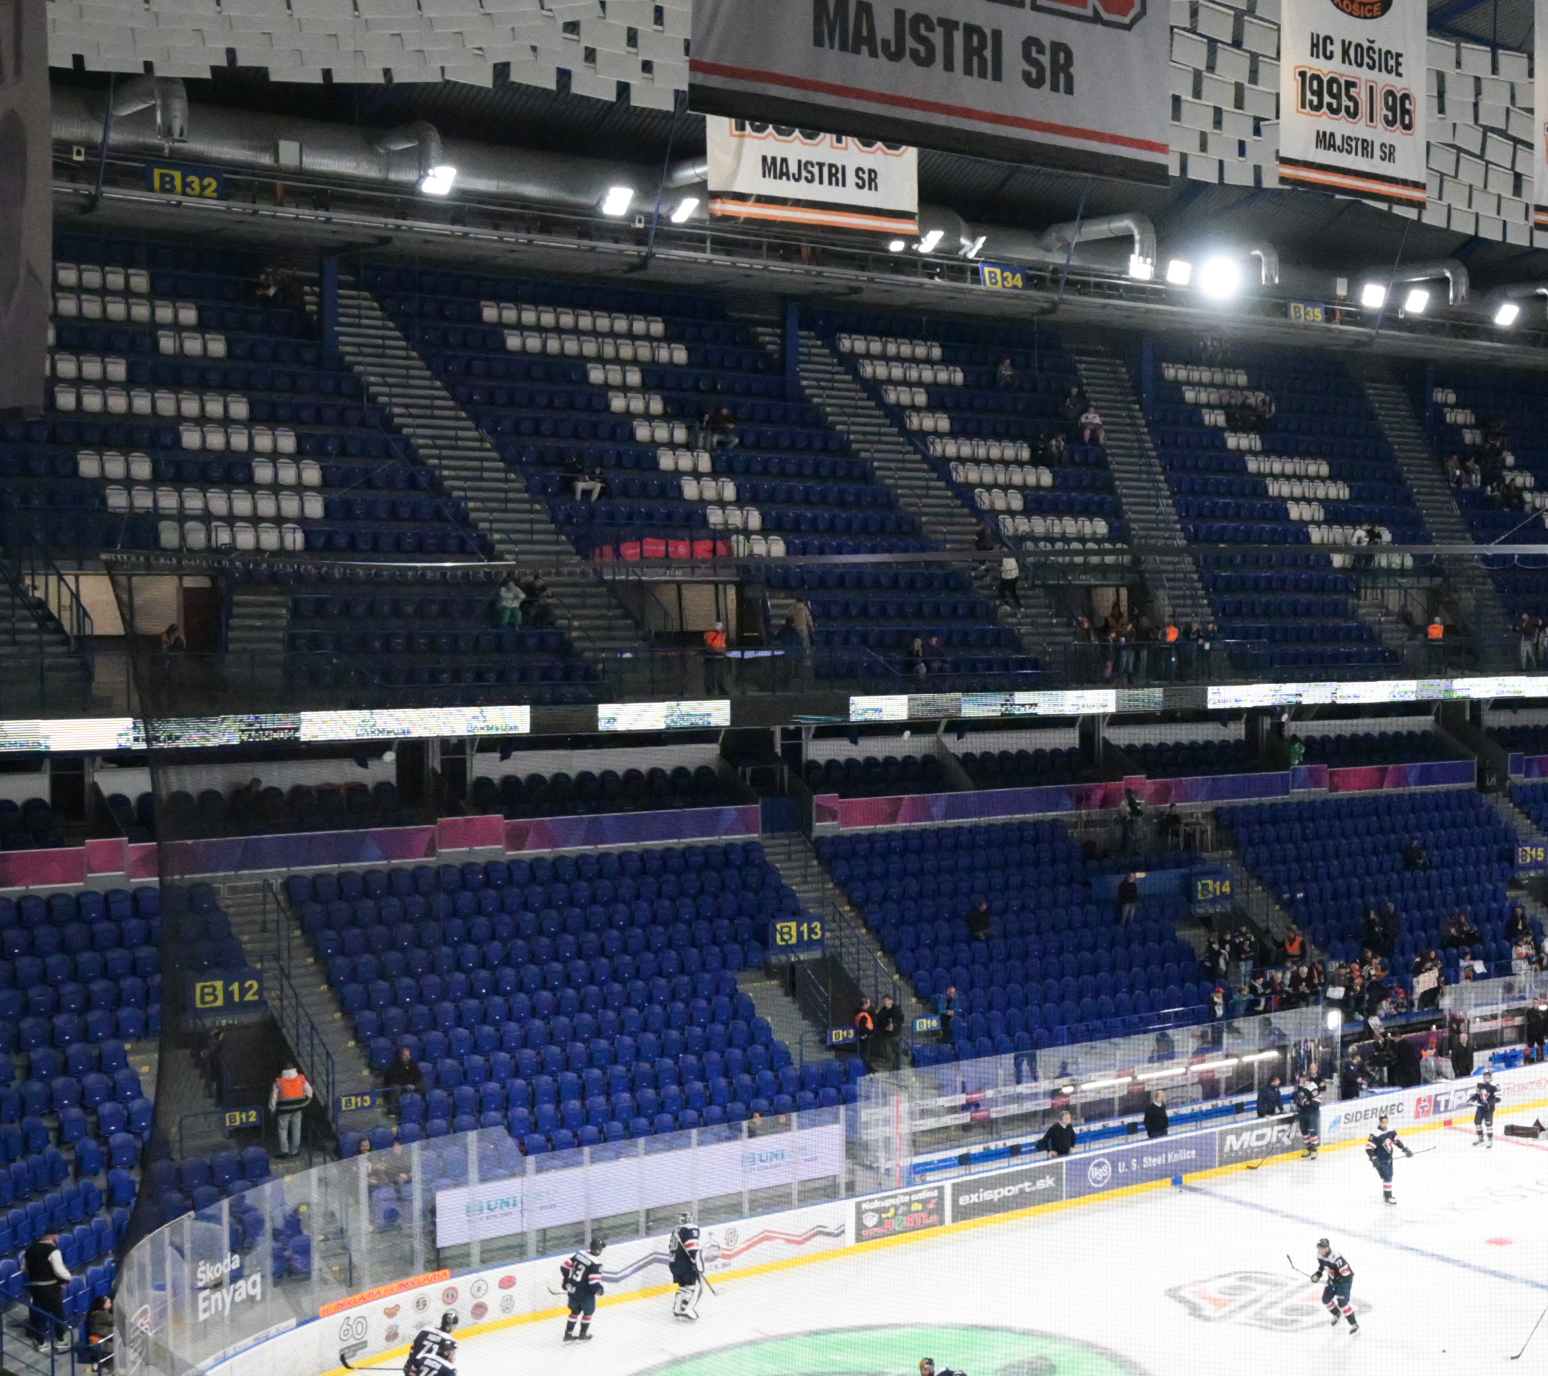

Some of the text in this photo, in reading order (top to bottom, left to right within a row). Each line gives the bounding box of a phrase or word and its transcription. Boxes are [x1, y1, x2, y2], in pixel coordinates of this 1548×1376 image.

[1022, 36, 1074, 95] SR
[1310, 32, 1403, 78] HC KOŠICE
[1315, 129, 1396, 164] MAJSTRI SR
[762, 156, 878, 191] MAJSTRI SR
[1343, 1101, 1404, 1126] SIDERMEC
[1142, 1153, 1164, 1170] Steel
[1166, 1146, 1197, 1166] Košice
[862, 1188, 939, 1212] Nakupujte online
[958, 1174, 1056, 1206] exisport.sk
[197, 1252, 240, 1286] Škoda
[198, 1268, 262, 1321] Enyaq
